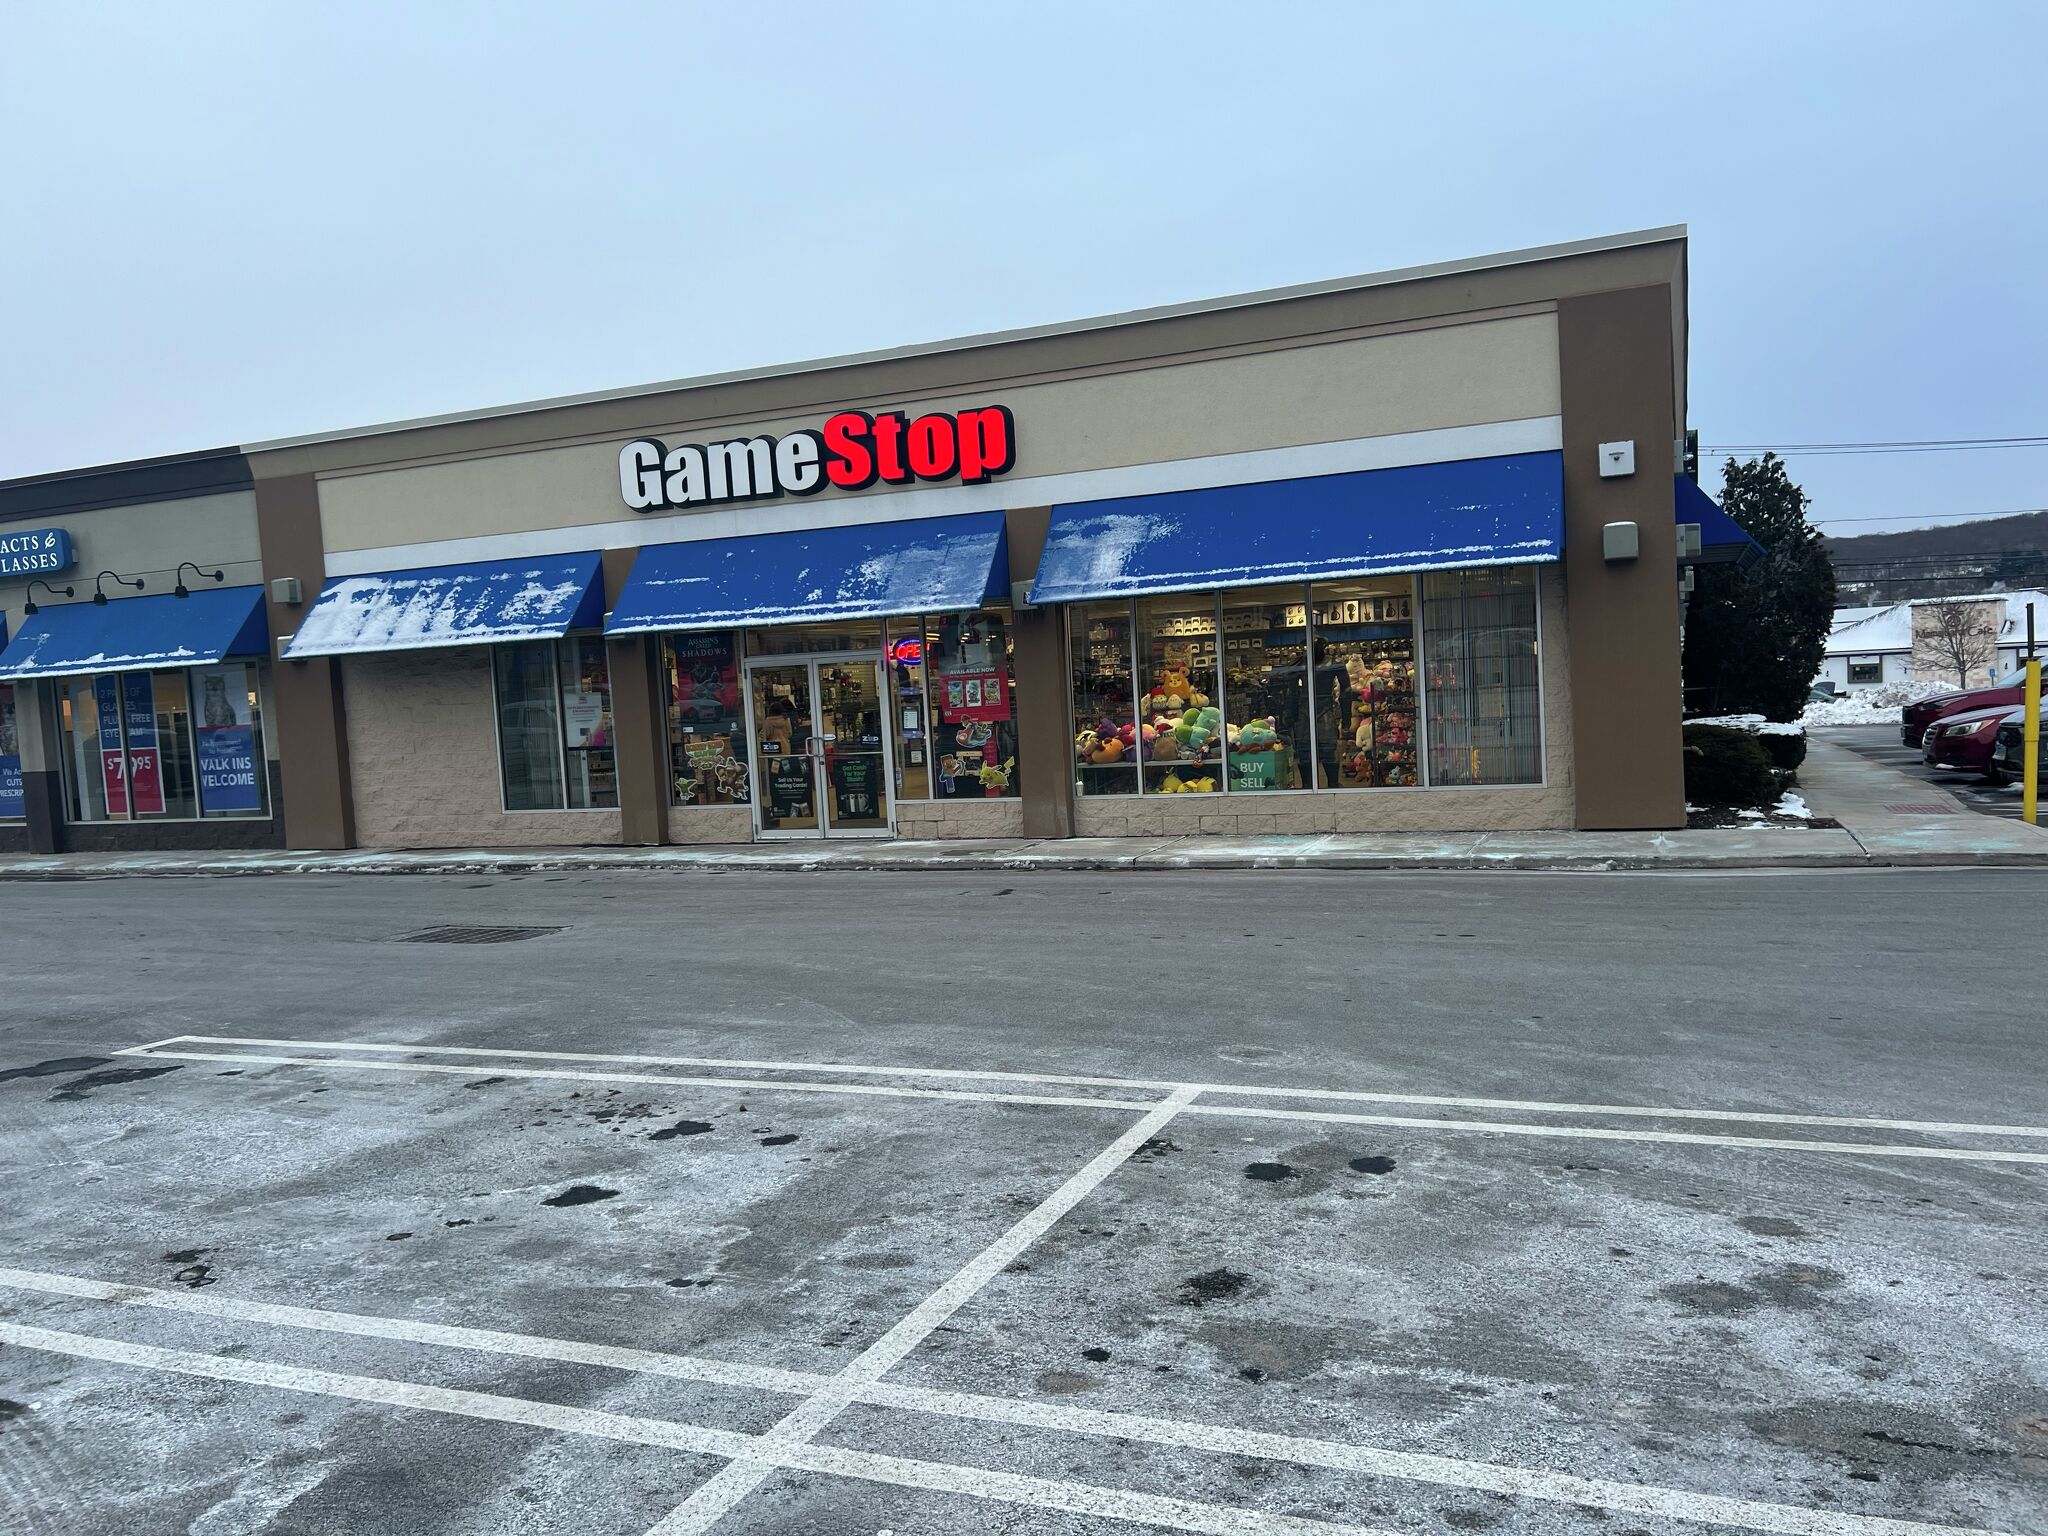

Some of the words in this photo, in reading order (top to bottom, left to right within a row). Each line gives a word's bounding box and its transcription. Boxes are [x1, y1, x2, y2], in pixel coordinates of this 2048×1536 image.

[619, 405, 1013, 512] GameStop
[0, 552, 58, 573] LASSES
[682, 647, 728, 658] SHADOWS
[949, 667, 979, 675] AVAILABLE
[130, 713, 152, 724] FREE
[231, 756, 252, 770] INS
[1240, 762, 1265, 773] BUY
[1240, 778, 1266, 788] SELL
[0, 788, 25, 798] RESCRIP
